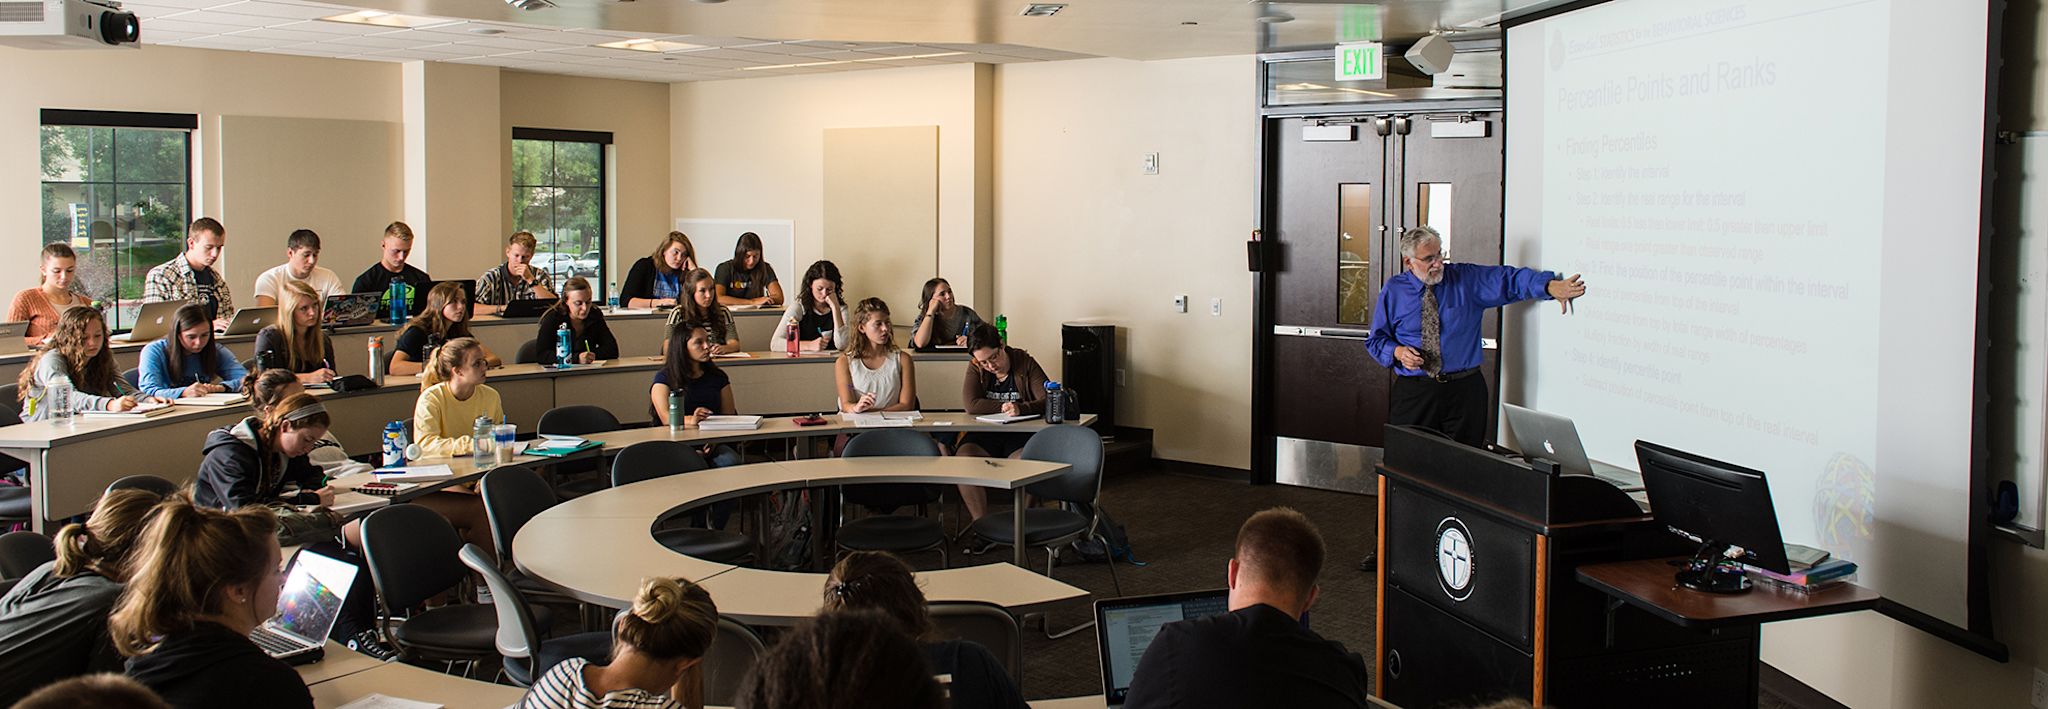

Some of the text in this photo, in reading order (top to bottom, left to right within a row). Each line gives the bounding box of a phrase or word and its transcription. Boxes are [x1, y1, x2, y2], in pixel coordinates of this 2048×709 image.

[1599, 27, 1635, 49] STATISTICS
[1652, 13, 1703, 38] BEHAVIORAL
[1704, 5, 1747, 27] SCIENCES
[1343, 48, 1375, 76] EXIT
[1558, 56, 1776, 112] Percentile Points and Ranks
[1566, 131, 1657, 159] Finding Percentiles
[1576, 167, 1591, 182] Step
[1600, 165, 1625, 183] Identify
[1627, 166, 1640, 179] the
[1641, 164, 1670, 179] interval
[1575, 191, 1590, 207] Step
[1600, 191, 1625, 207] Identify
[1627, 191, 1640, 206] the
[1641, 192, 1655, 206] real
[1657, 193, 1680, 209] range
[1681, 189, 1694, 206] for
[1696, 189, 1709, 206] the
[1711, 190, 1746, 207] interval
[1666, 216, 1685, 231] lower
[1706, 216, 1721, 232] 0.5
[1722, 219, 1753, 237] greater
[1754, 217, 1776, 235] than
[1777, 222, 1805, 240] upper
[1807, 219, 1828, 237] limit
[1680, 241, 1697, 256] than
[1698, 242, 1737, 258] observed
[1738, 247, 1764, 264] range
[1599, 260, 1614, 276] Find
[1616, 262, 1627, 277] the
[1629, 264, 1659, 281] position
[1660, 266, 1669, 281] of
[1670, 266, 1682, 283] the
[1684, 270, 1727, 288] percentile
[1729, 273, 1753, 292] point
[1756, 274, 1785, 293] within
[1787, 275, 1805, 295] the
[1807, 279, 1849, 301] interval
[1621, 289, 1653, 304] percentile
[1654, 291, 1670, 305] from
[1672, 294, 1685, 310] top
[1686, 296, 1694, 309] of
[1695, 296, 1708, 311] the
[1709, 298, 1740, 316] interval
[1633, 311, 1648, 327] from
[1649, 315, 1660, 332] top
[1661, 317, 1671, 334] by
[1672, 319, 1688, 335] total
[1690, 323, 1713, 341] range
[1715, 325, 1737, 342] width
[1738, 328, 1749, 344] of
[1750, 334, 1807, 356] percentages
[1572, 347, 1587, 365] Step
[1597, 352, 1622, 375] Identify
[1623, 361, 1660, 380] percentile
[1661, 367, 1682, 385] point
[1663, 341, 1672, 355] of
[1687, 348, 1711, 365] range
[1635, 386, 1643, 401] of
[1643, 390, 1678, 410] percentile
[1679, 399, 1699, 415] point
[1700, 402, 1719, 418] from
[1720, 407, 1735, 427] top
[1735, 410, 1746, 427] of
[1746, 413, 1761, 431] the
[1763, 418, 1782, 436] real
[1783, 423, 1819, 446] interval
